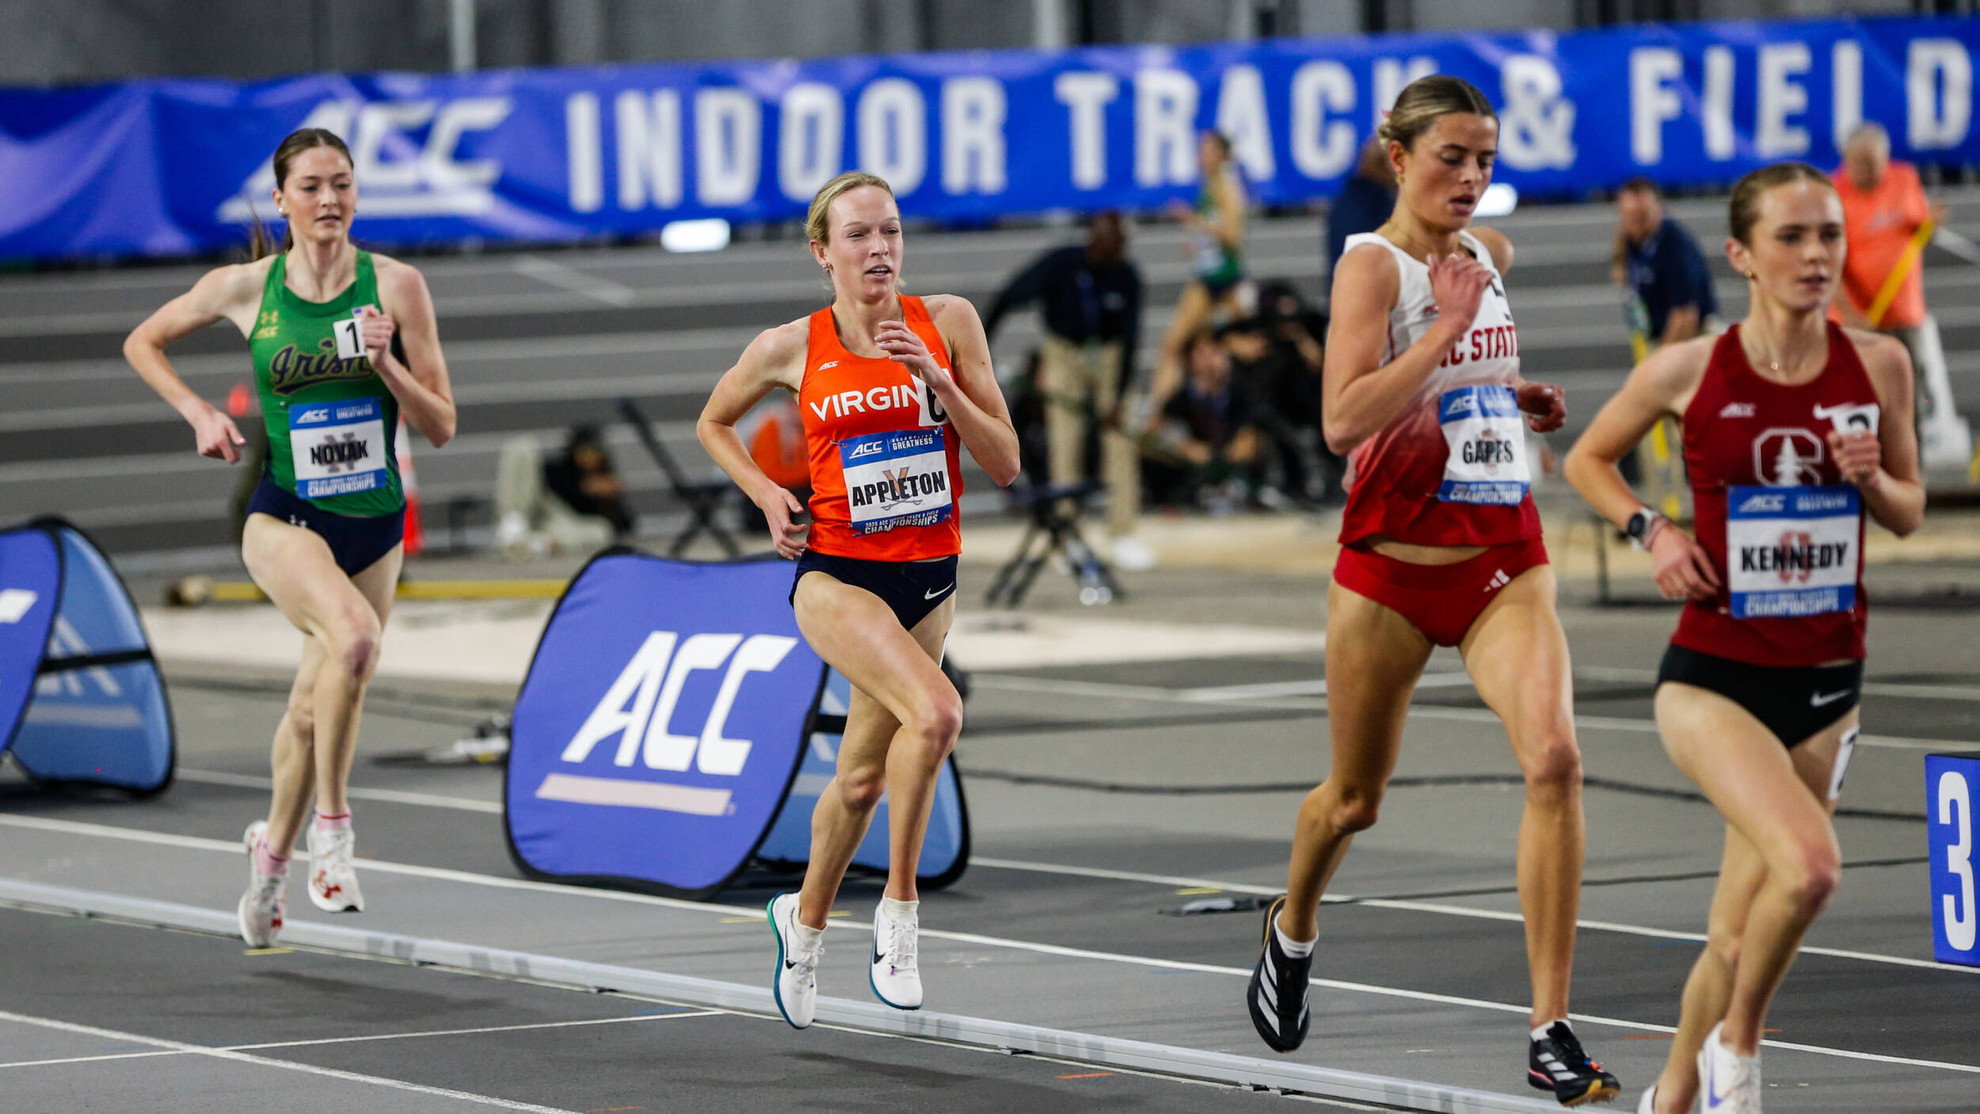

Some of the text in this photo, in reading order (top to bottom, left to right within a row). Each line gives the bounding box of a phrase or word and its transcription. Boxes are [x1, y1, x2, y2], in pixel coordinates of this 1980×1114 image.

[567, 77, 1008, 214] INDOOR
[1499, 53, 1577, 172] &
[1630, 38, 1973, 165] FIELD
[346, 321, 360, 354] 1
[1440, 333, 1465, 368] C
[818, 360, 839, 371] ACC
[296, 408, 330, 424] ACC
[311, 440, 369, 465] NOVAK
[849, 440, 883, 459] ACC
[892, 437, 933, 451] GREATNESS
[852, 470, 947, 507] APPLETON
[1739, 494, 1786, 513] ACC
[865, 514, 939, 535] CHAMPIONSHIPS
[1742, 541, 1847, 572] KENNEDY
[561, 631, 797, 776] ACC
[1938, 771, 1976, 951] 3
